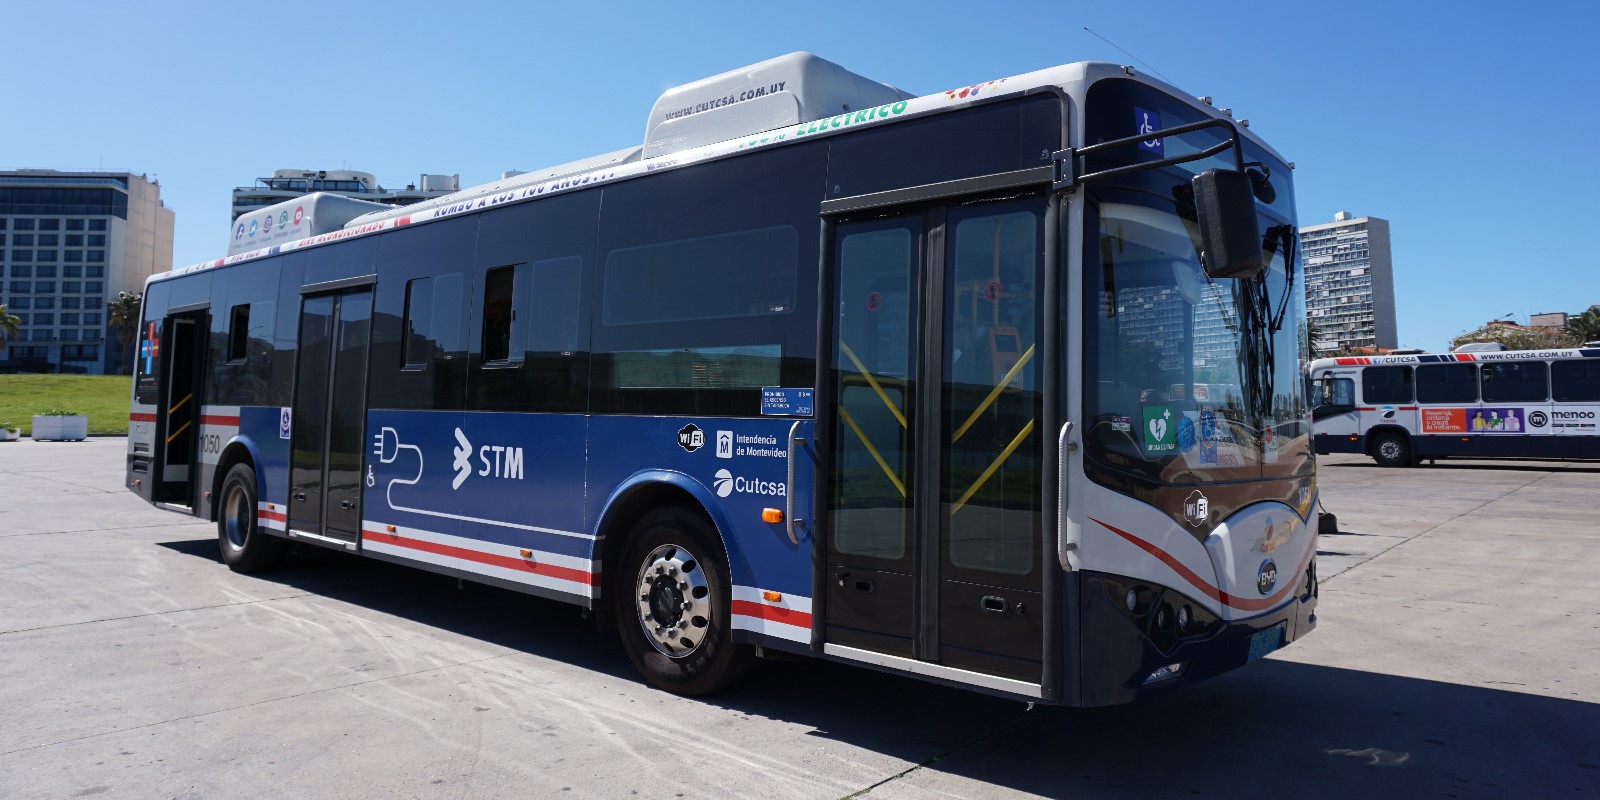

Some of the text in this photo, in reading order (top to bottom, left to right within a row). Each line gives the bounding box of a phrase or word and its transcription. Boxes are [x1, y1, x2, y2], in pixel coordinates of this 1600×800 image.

[665, 81, 786, 121] WWW.CUTCSA.COM.UY
[1480, 351, 1573, 360] WWW.CUTCSA.COM.UY
[1551, 411, 1595, 419] menoo
[200, 433, 220, 454] 1050
[736, 434, 777, 445] Intendencia
[736, 446, 787, 458] de Montevideo
[478, 445, 524, 480] STM
[735, 476, 787, 497] Cutcsa
[1261, 569, 1276, 586] BYD
